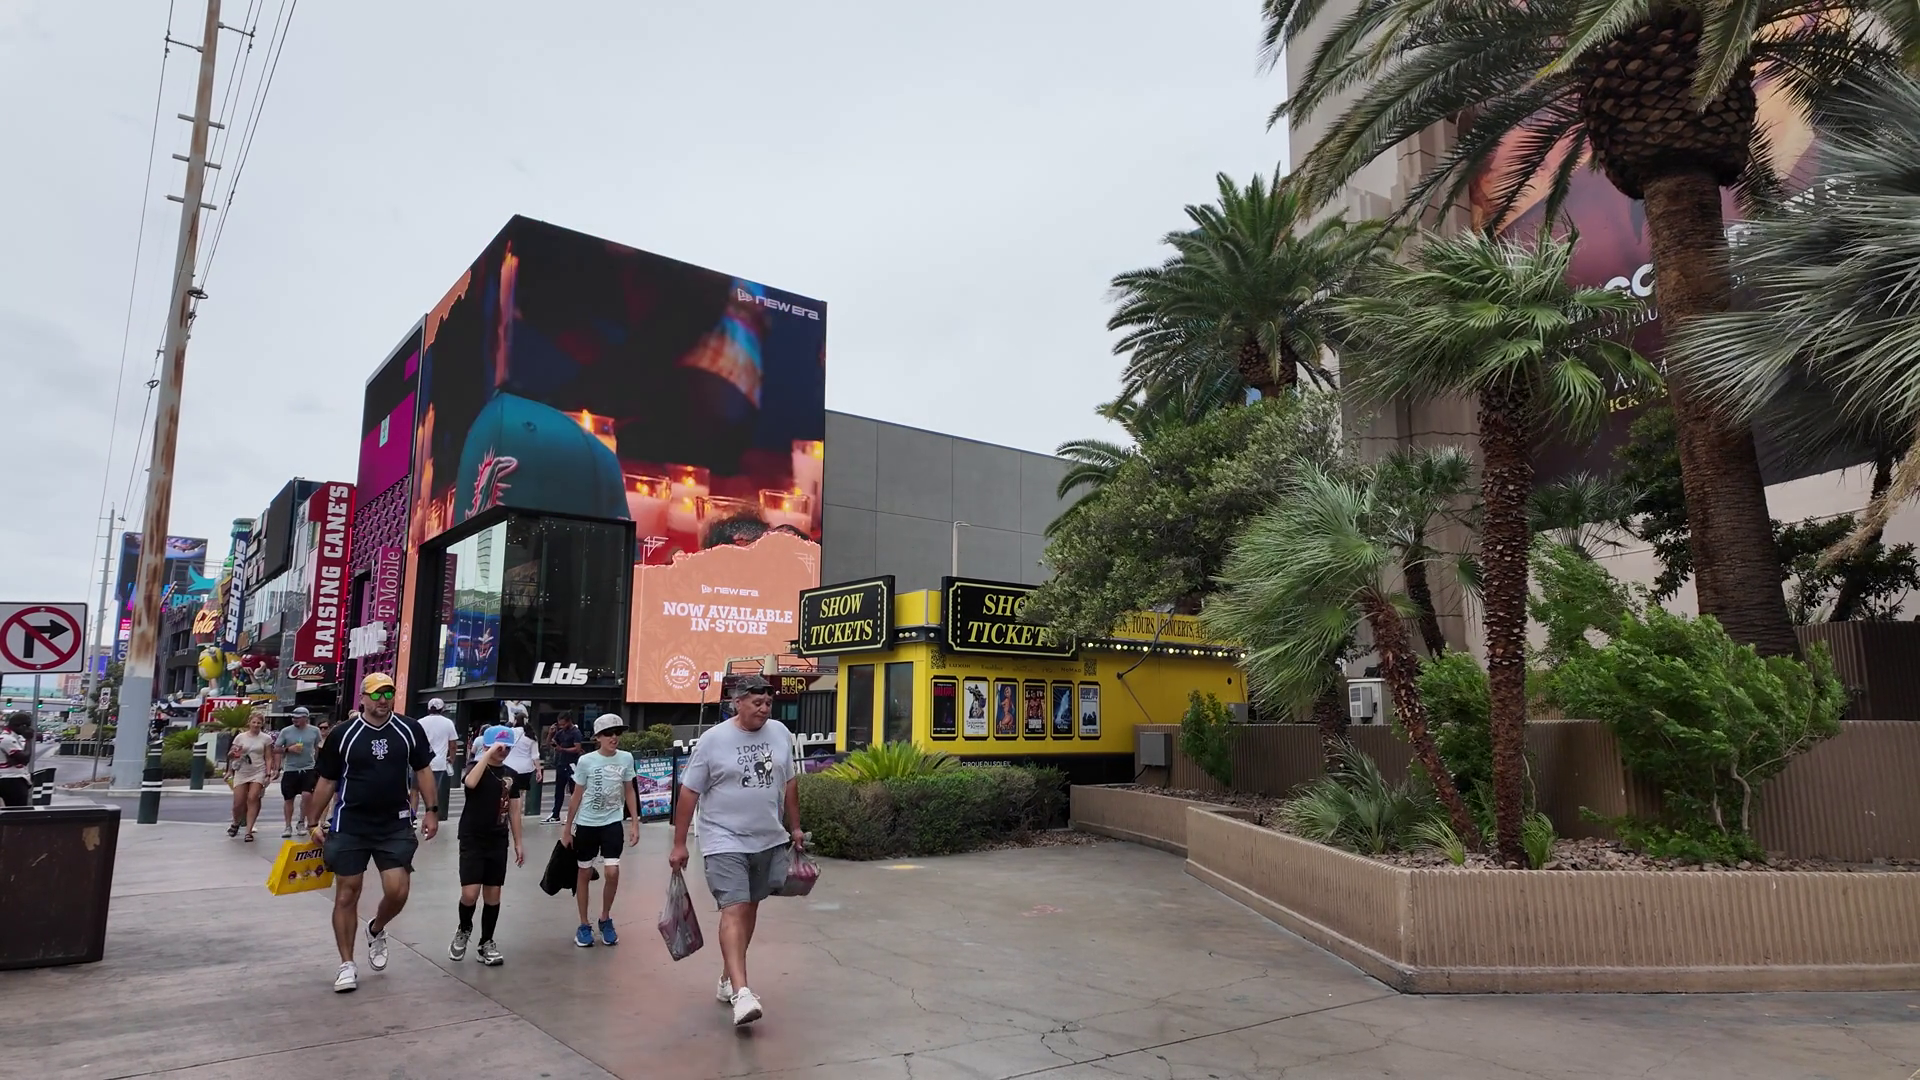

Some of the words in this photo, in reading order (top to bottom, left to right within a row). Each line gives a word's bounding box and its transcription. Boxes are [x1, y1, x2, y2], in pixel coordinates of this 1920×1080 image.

[323, 485, 349, 559] CANE'S
[225, 539, 247, 645] SKECHERS
[313, 565, 342, 659] RAISING
[662, 601, 705, 617] NOW
[706, 605, 793, 624] AVAILABLE
[819, 592, 864, 619] SHOW
[982, 593, 1026, 618] SHO
[690, 617, 768, 635] IN-STORE
[810, 619, 874, 646] TICKETS
[287, 663, 326, 679] Cane's
[532, 661, 590, 685] Lids
[781, 677, 796, 686] BIG
[781, 686, 796, 695] BUS
[736, 746, 742, 755] I
[743, 741, 770, 754] DON'T
[737, 752, 760, 765] GIVE
[743, 764, 751, 774] A
[592, 767, 603, 811] DINOSAUR
